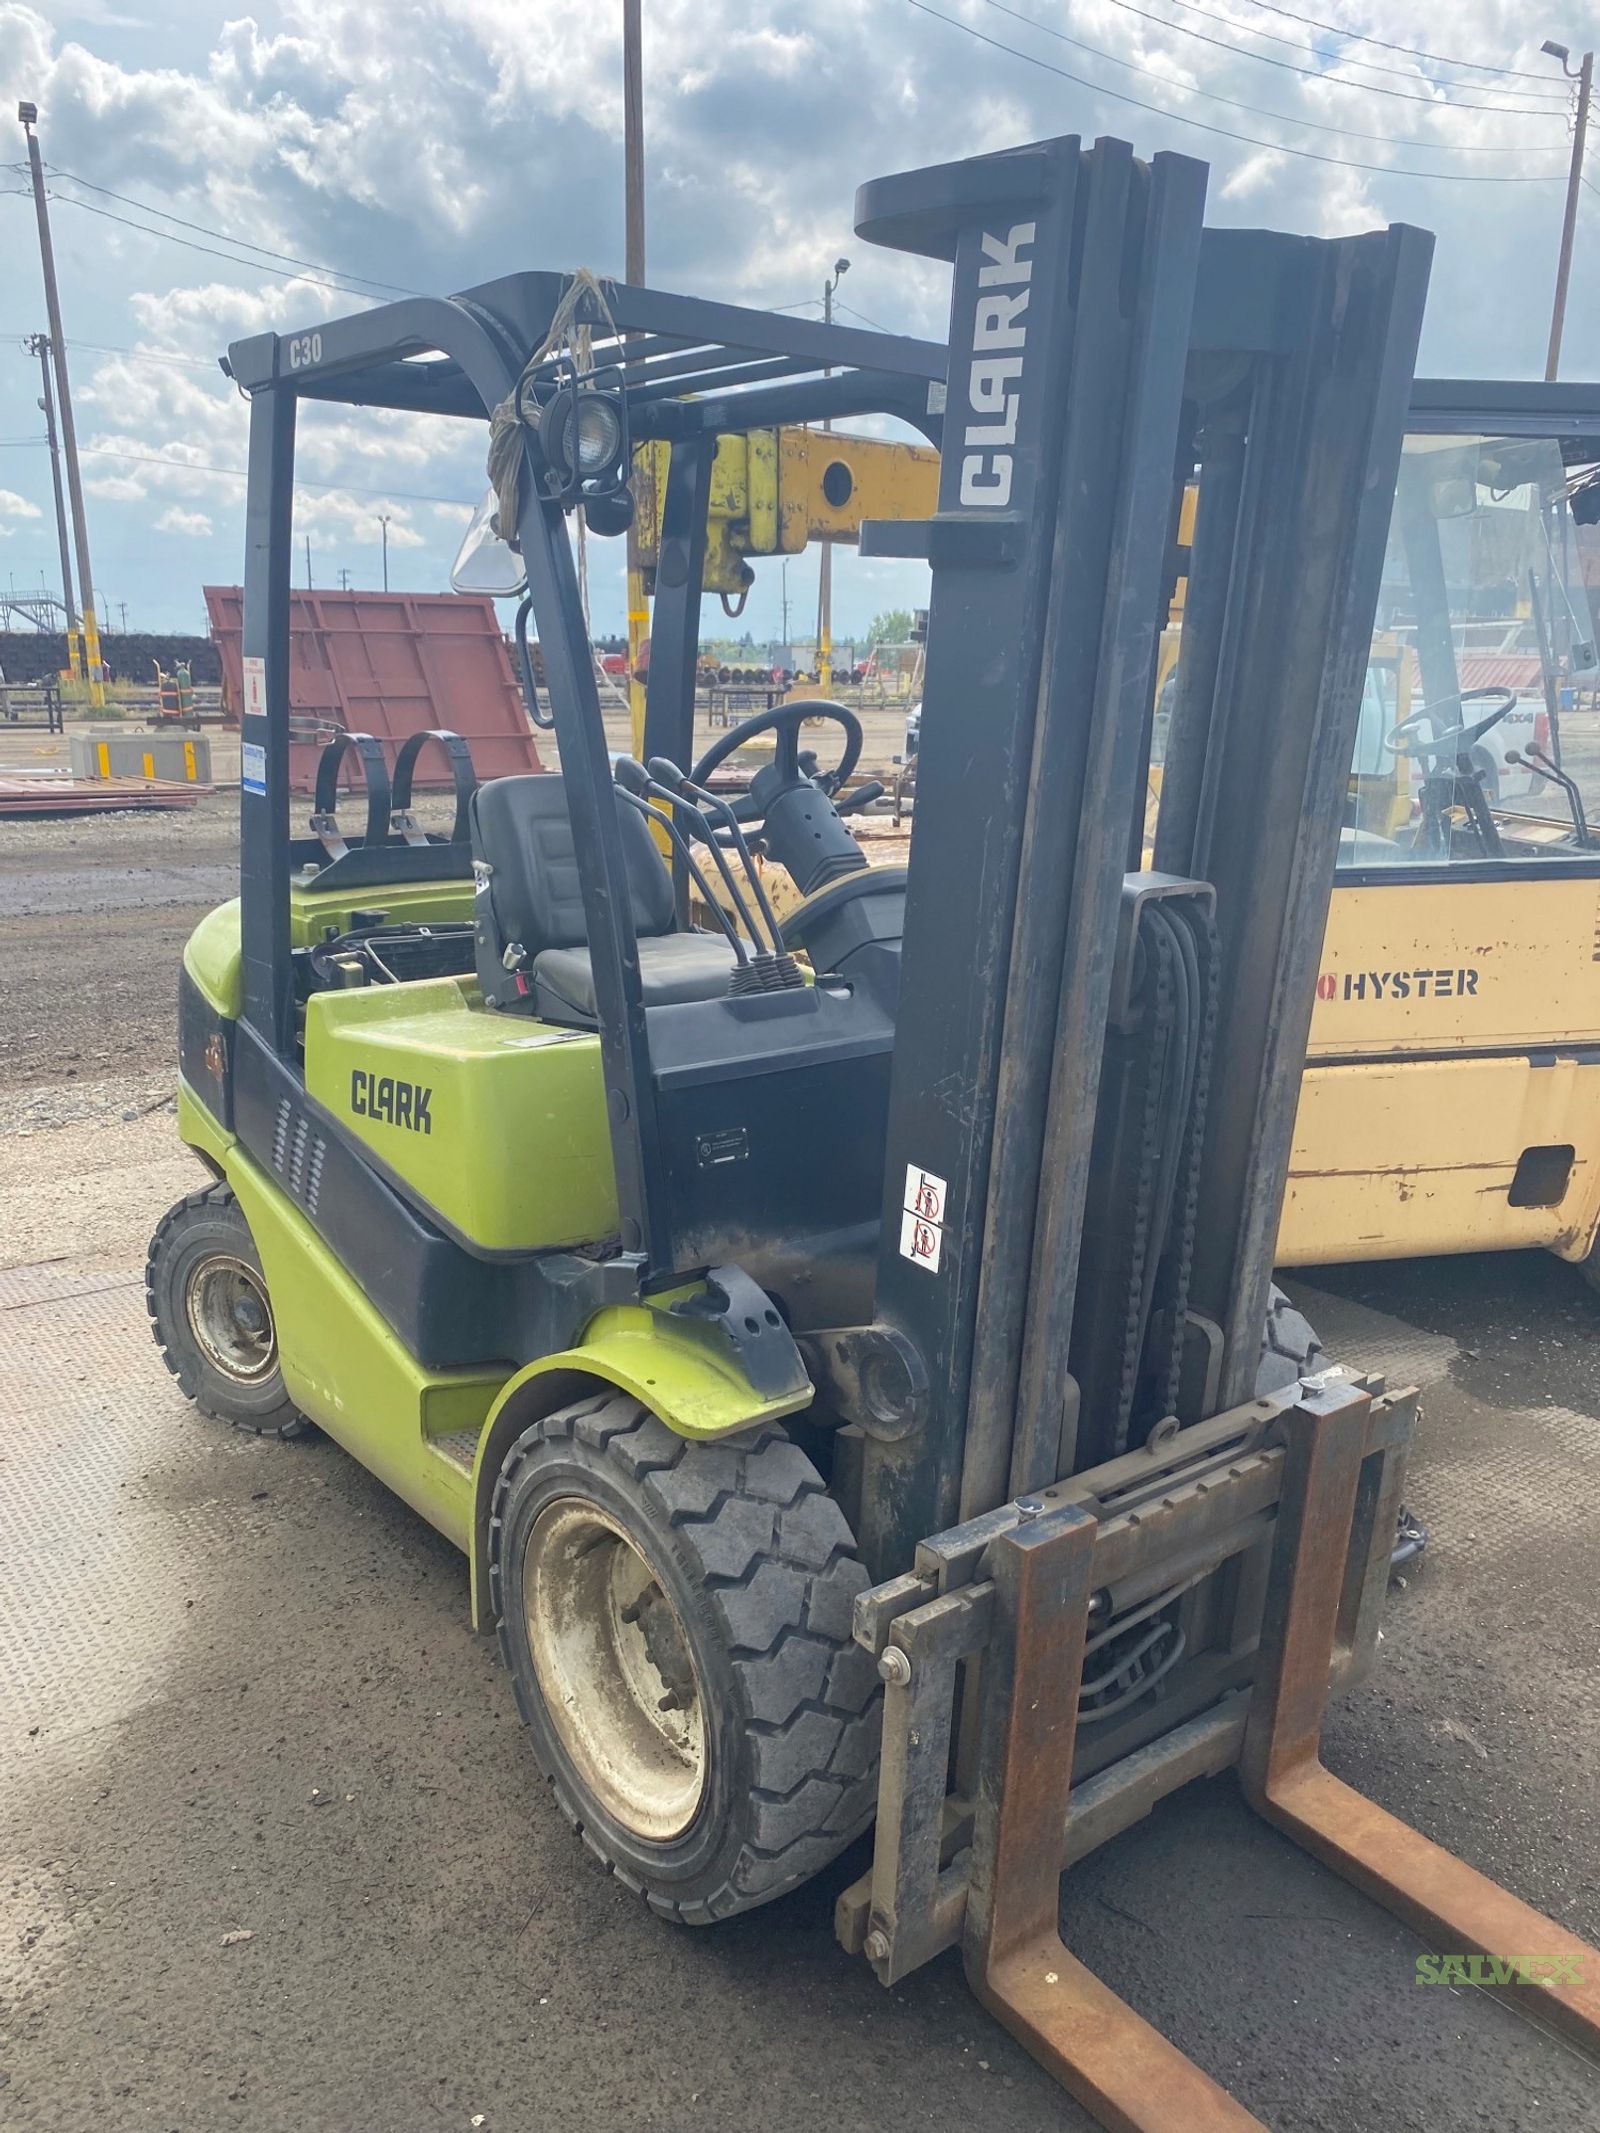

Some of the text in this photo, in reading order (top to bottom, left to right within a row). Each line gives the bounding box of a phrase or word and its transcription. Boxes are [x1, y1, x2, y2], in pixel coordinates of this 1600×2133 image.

[290, 333, 322, 369] C30
[959, 222, 1036, 506] CLARK
[1343, 969, 1479, 1000] HYSTER
[351, 1069, 432, 1135] CLARK
